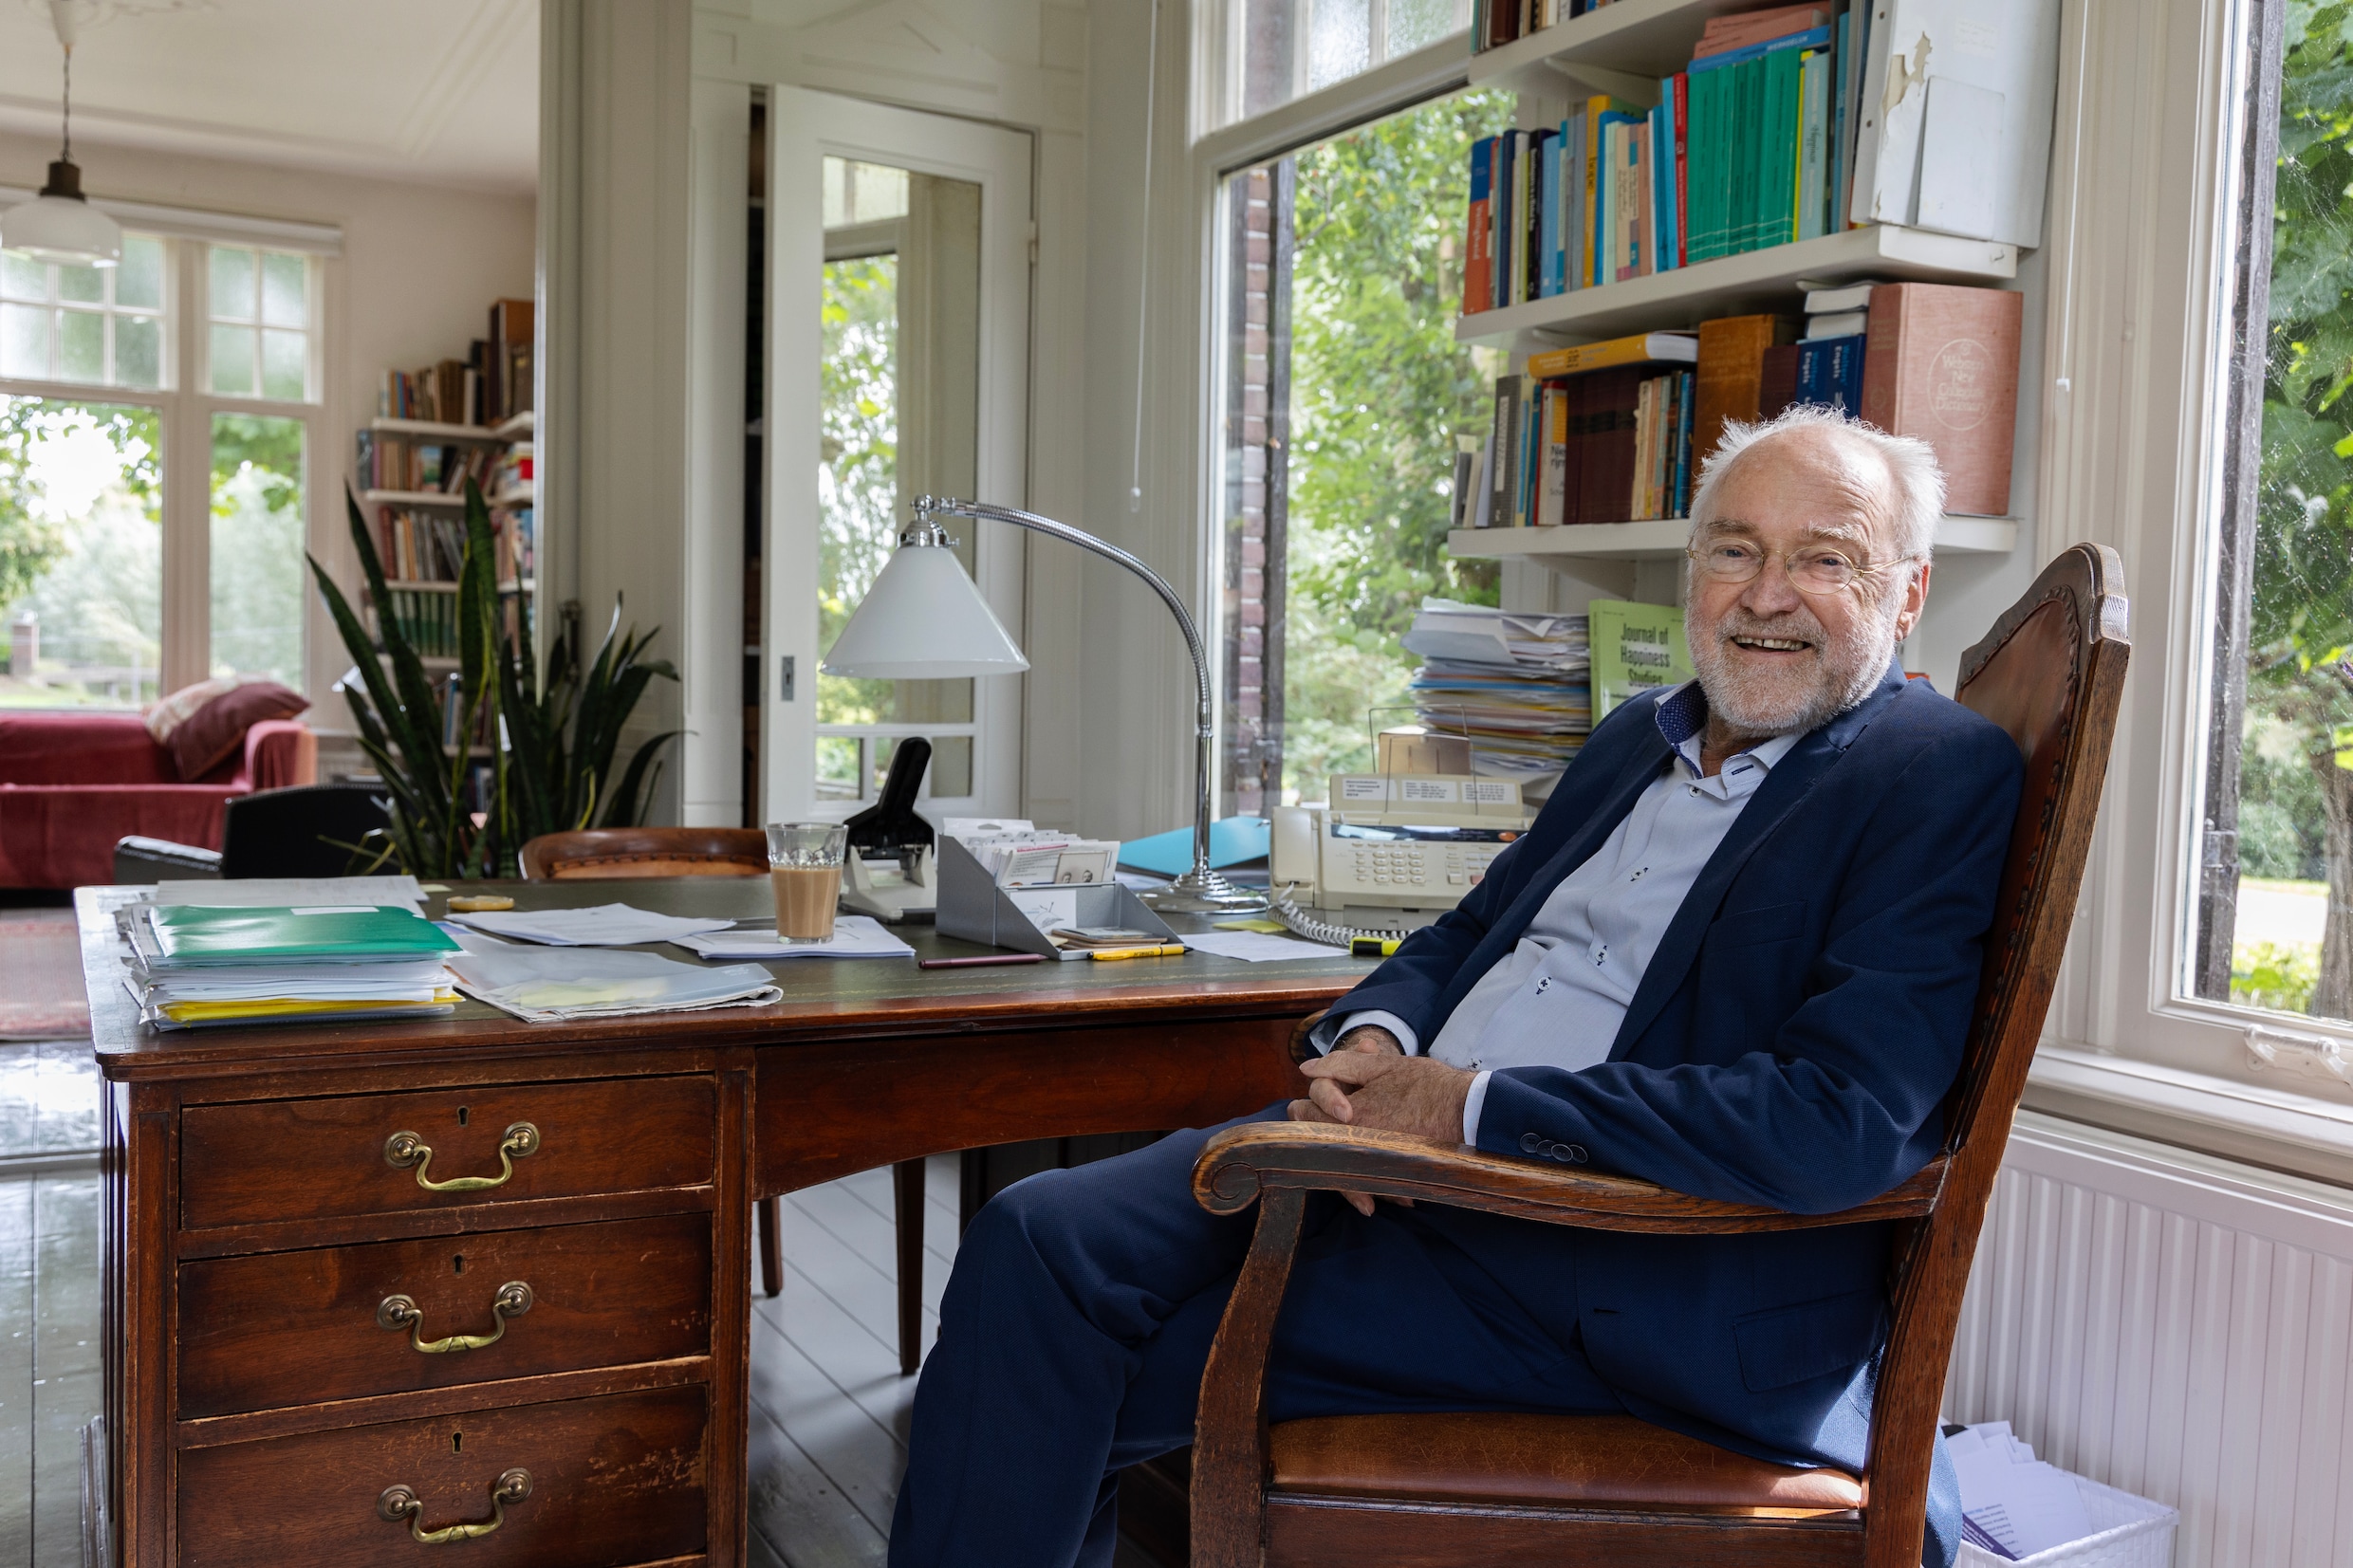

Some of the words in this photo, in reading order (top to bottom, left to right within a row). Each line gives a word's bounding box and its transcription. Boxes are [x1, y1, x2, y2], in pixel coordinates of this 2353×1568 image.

[1802, 352, 1812, 383] Engels
[1832, 345, 1843, 378] Engels
[1621, 623, 1656, 643] Journal
[1658, 628, 1669, 645] of
[1621, 645, 1670, 668] Happiness
[1628, 668, 1663, 688] Studies
